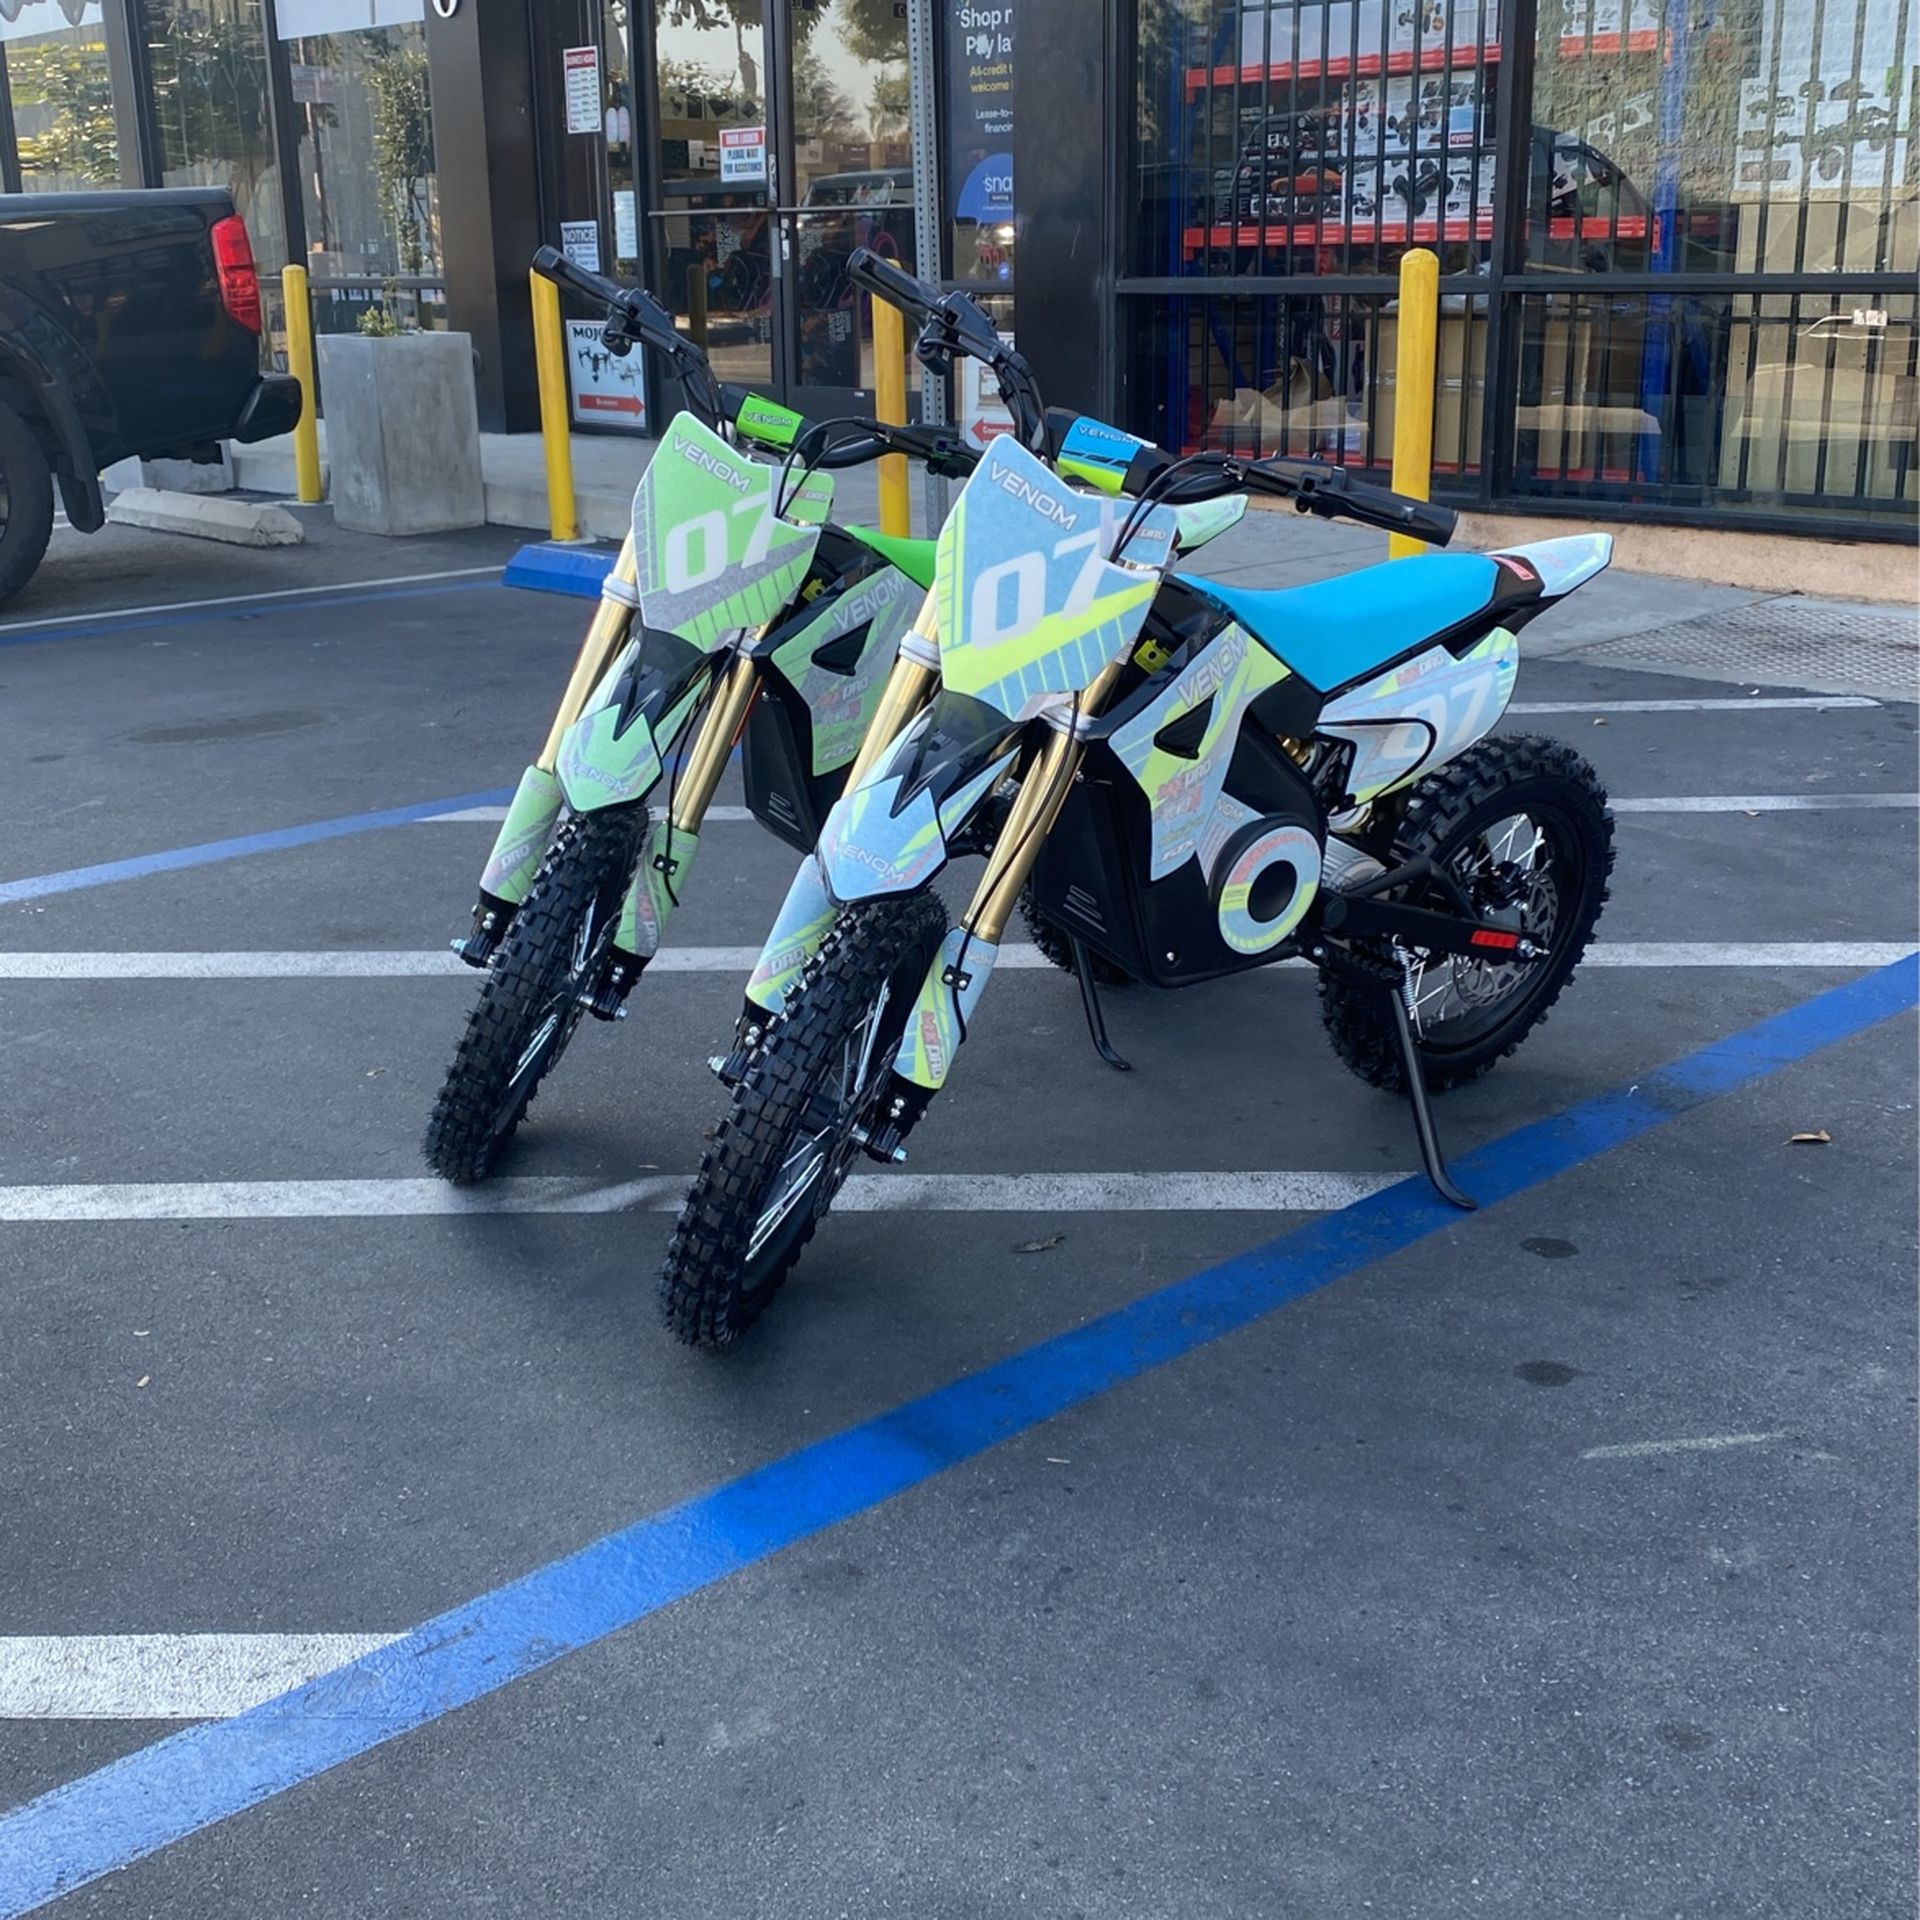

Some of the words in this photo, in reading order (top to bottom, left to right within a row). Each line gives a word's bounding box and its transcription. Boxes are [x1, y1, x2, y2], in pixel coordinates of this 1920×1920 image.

[960, 8, 1001, 30] Shop
[975, 108, 1013, 119] Lease-to-
[984, 123, 1013, 132] financi
[984, 175, 1013, 193] sna
[563, 229, 596, 242] NOTICE
[744, 411, 793, 428] VENOM
[1078, 423, 1140, 446] VENOM
[672, 434, 752, 494] VENOM
[989, 459, 1078, 532] VENOM
[665, 490, 776, 595] 07
[833, 567, 904, 630] VENOM
[971, 527, 1106, 650] 07
[1178, 624, 1248, 709] VENOM
[1381, 672, 1494, 761] 07
[567, 760, 630, 796] VENOM
[1216, 798, 1243, 822] NOM
[833, 840, 905, 884] VENOM
[950, 942, 993, 966] VNOM
